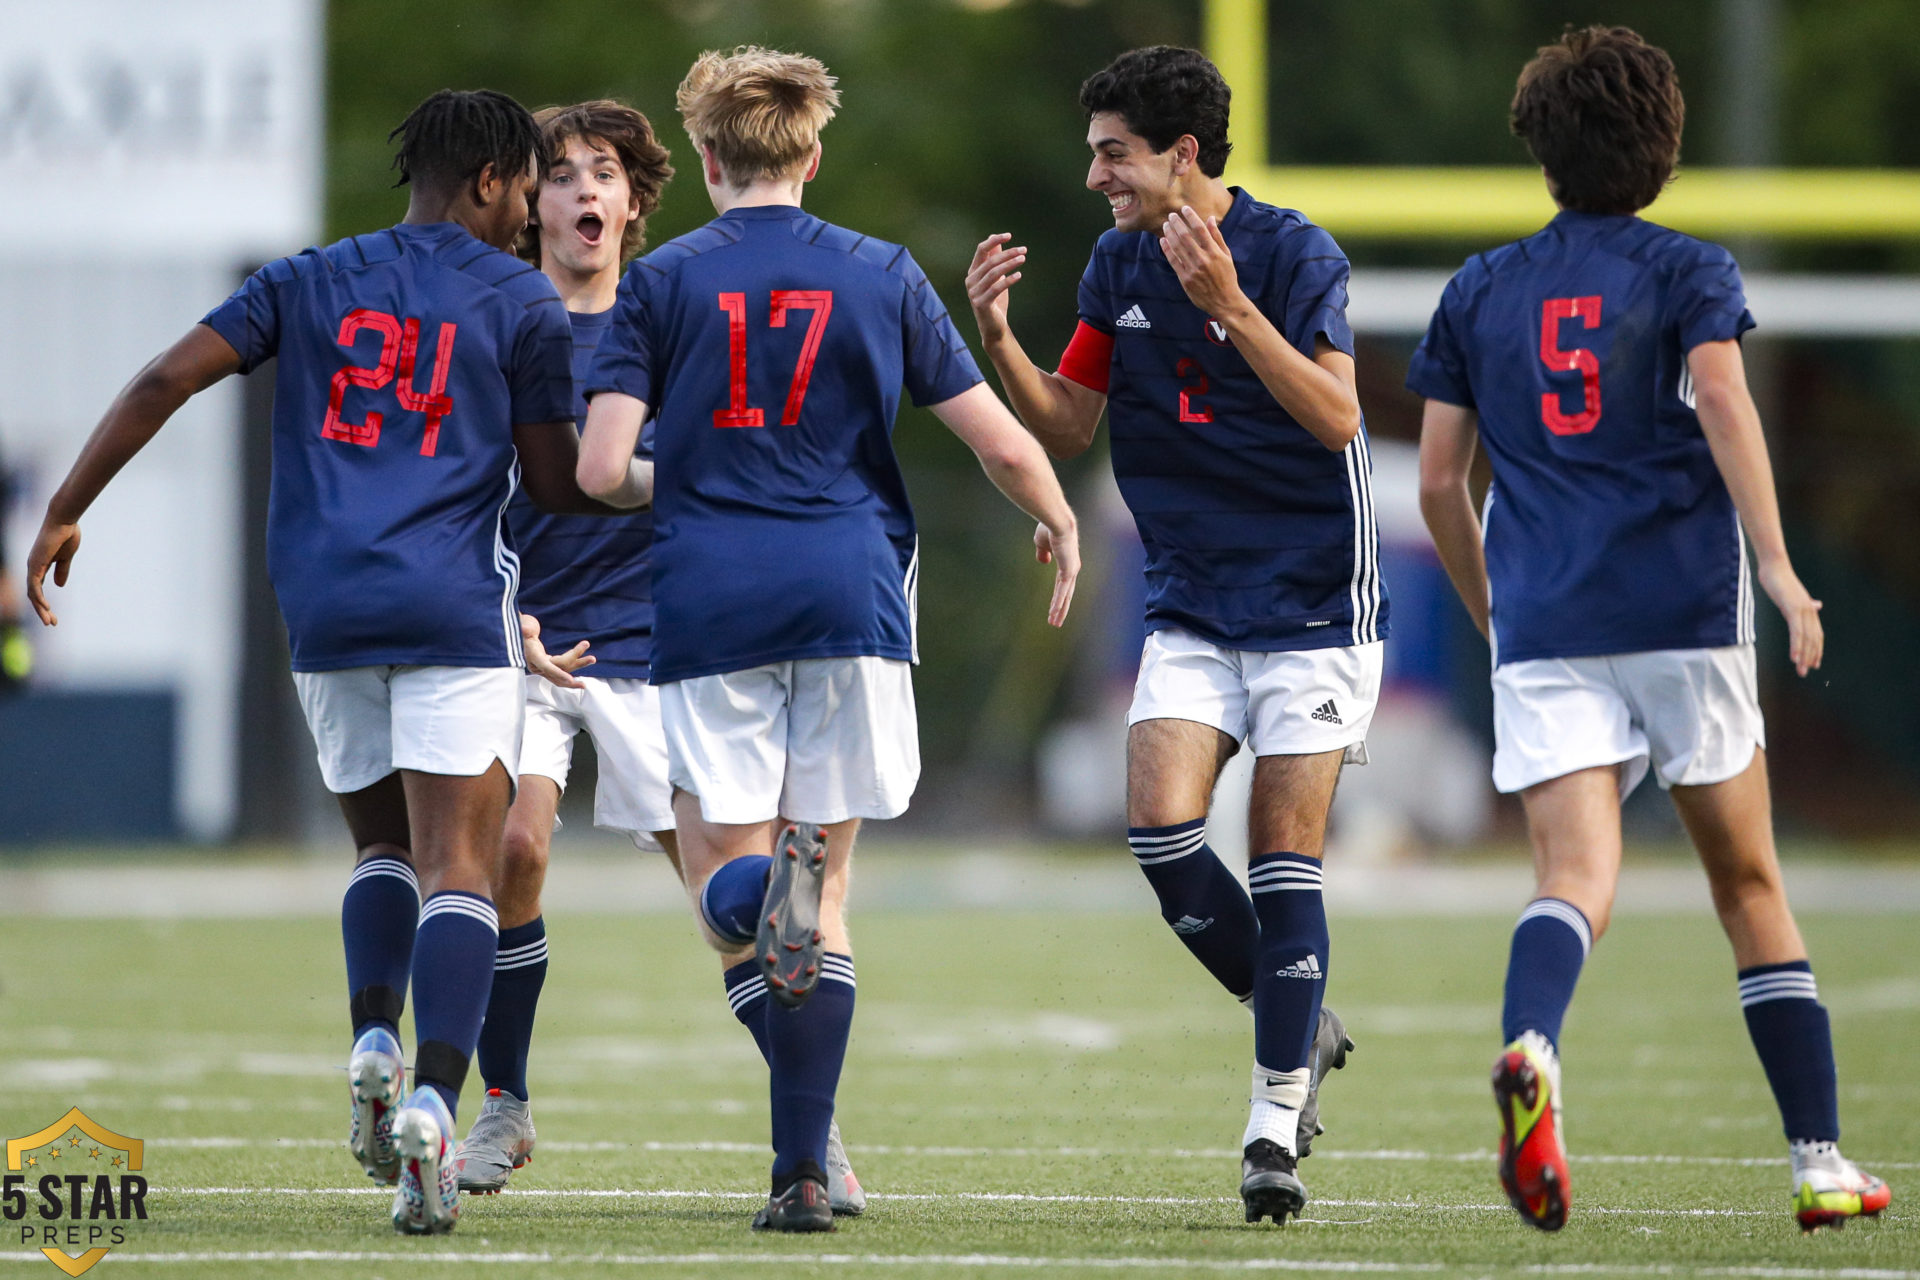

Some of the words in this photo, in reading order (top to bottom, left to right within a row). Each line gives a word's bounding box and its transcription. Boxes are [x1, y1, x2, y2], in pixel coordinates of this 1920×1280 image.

[713, 290, 833, 428] 17
[1116, 319, 1151, 329] adidas
[1540, 296, 1602, 436] 5
[321, 308, 457, 457] 24
[1176, 358, 1214, 423] 2
[1311, 712, 1343, 725] adidas
